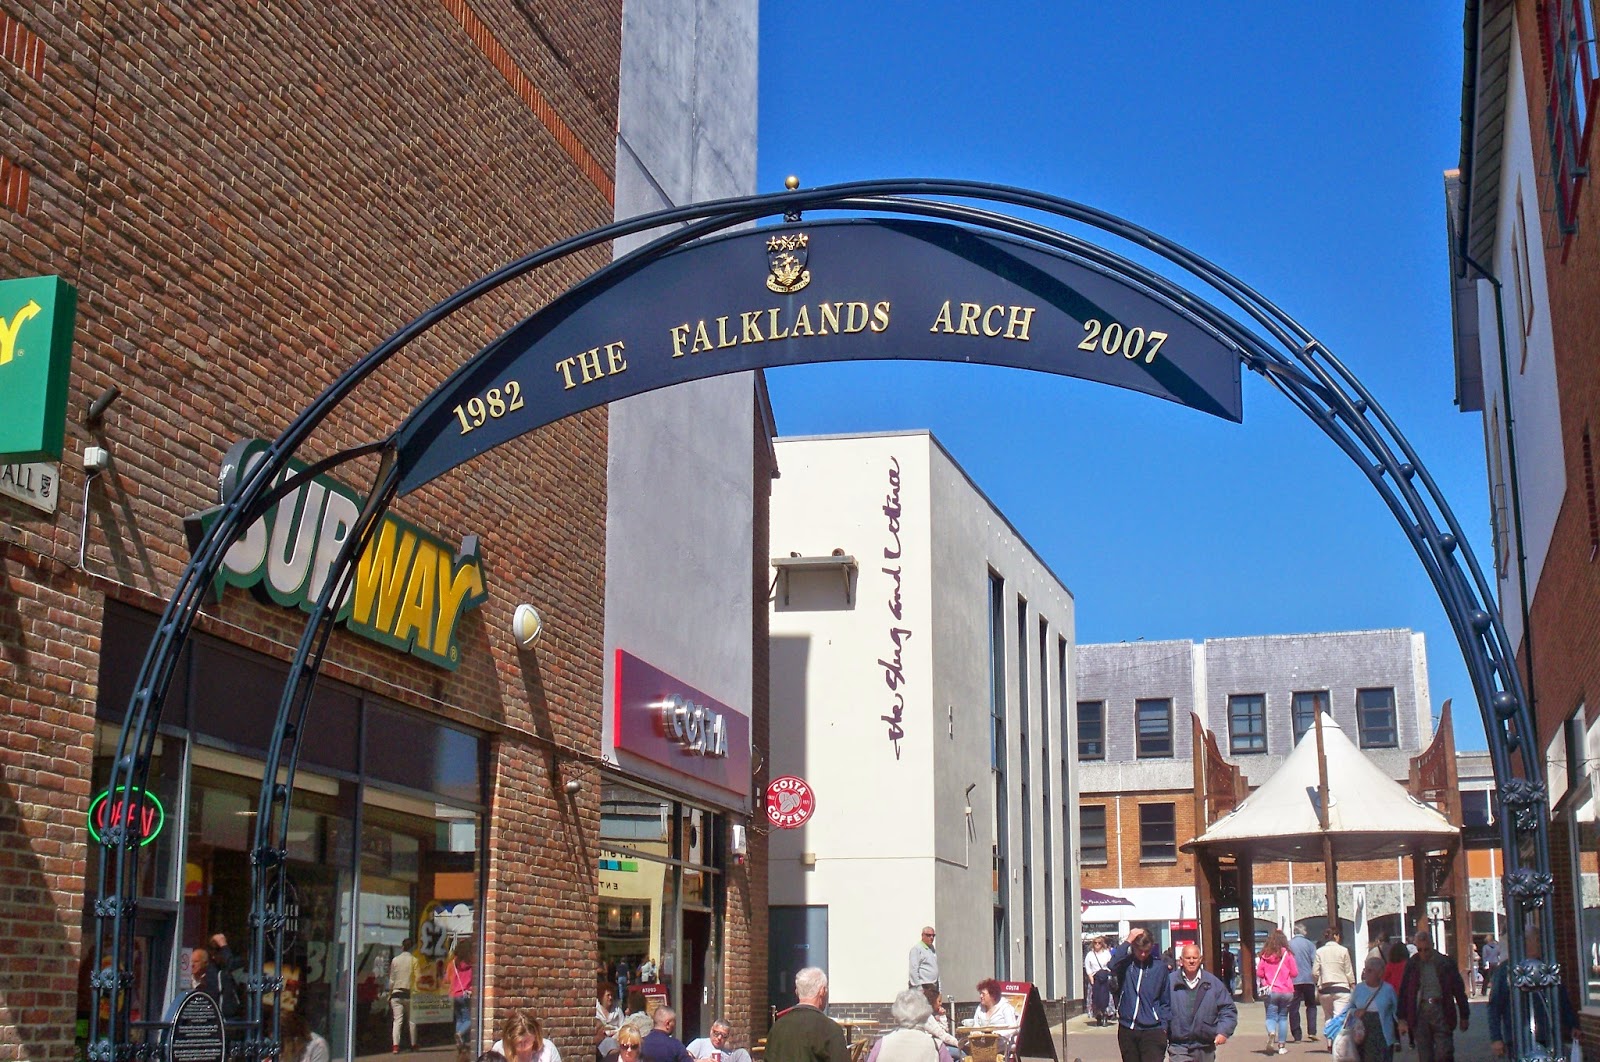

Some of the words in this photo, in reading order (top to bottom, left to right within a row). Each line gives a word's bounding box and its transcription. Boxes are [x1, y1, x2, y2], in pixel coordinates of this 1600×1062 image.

[453, 380, 525, 435] 1982
[555, 341, 628, 390] THE
[670, 301, 891, 358] FALKLANDS
[930, 300, 1036, 341] ARCH
[1077, 318, 1169, 364] 2007
[881, 565, 904, 620] and
[877, 627, 912, 691] Slug
[662, 693, 729, 758] COSTA
[767, 805, 807, 824] COFFEE
[773, 780, 806, 796] COSTA
